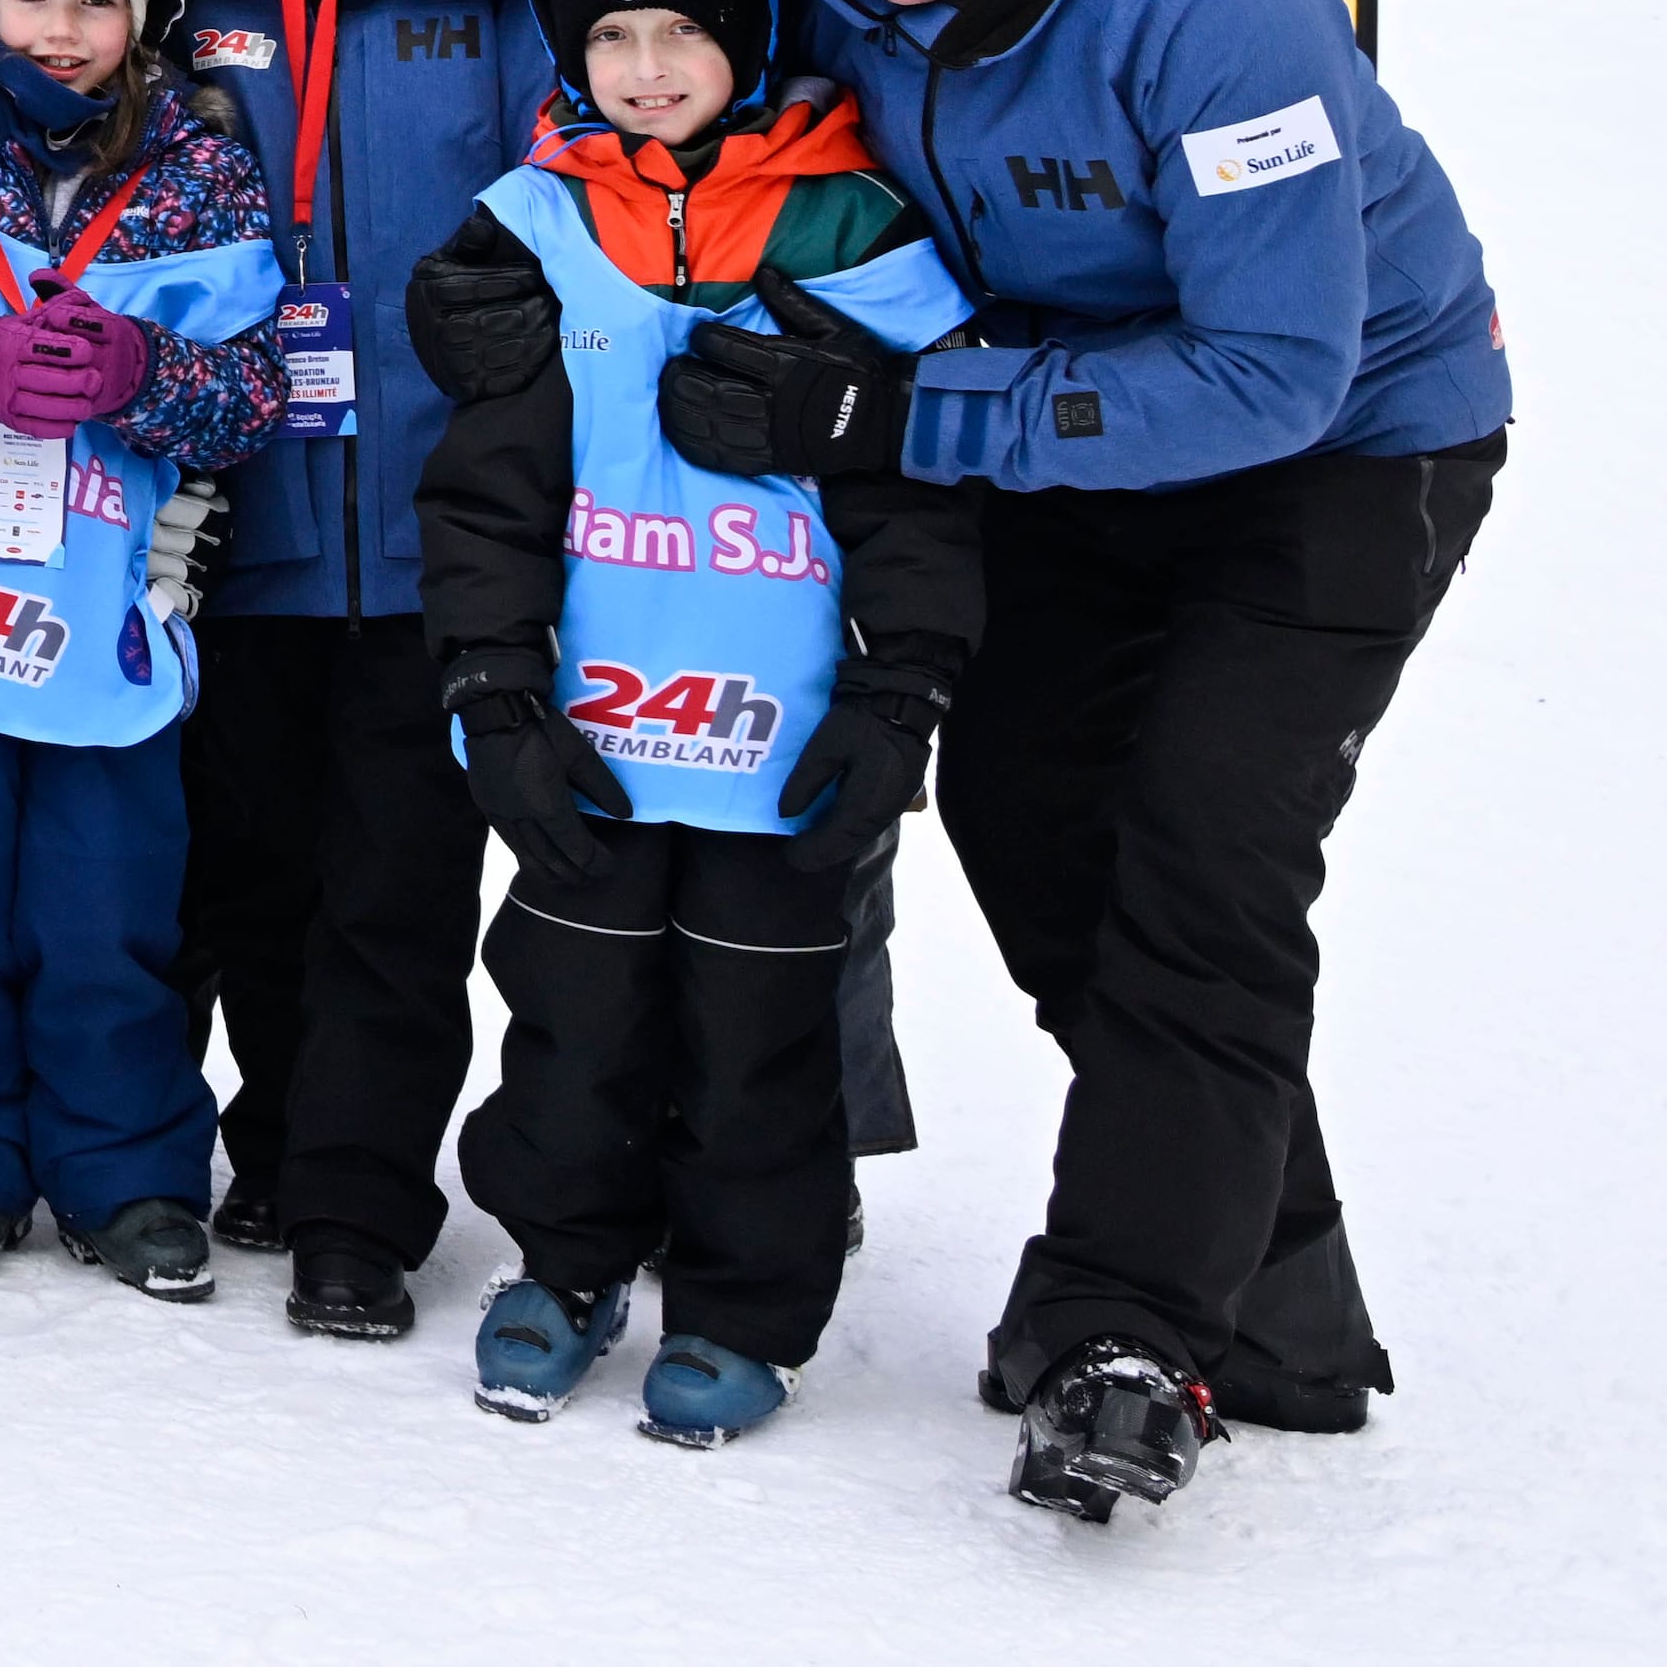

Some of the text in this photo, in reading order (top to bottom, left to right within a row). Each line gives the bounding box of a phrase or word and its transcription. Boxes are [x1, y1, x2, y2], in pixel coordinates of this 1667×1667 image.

[194, 30, 277, 60] 24h
[396, 16, 481, 61] HH
[1247, 140, 1316, 174] Sun Life
[1005, 155, 1126, 211] HH
[280, 304, 328, 321] 24h
[572, 330, 609, 351] Life
[289, 368, 325, 377] NDATION
[291, 377, 340, 388] LES-BRUNEAU
[830, 385, 859, 439] HESTRA
[565, 490, 829, 583] iam S.J.
[569, 666, 778, 743] 24h
[586, 728, 763, 768] REMBLANT
